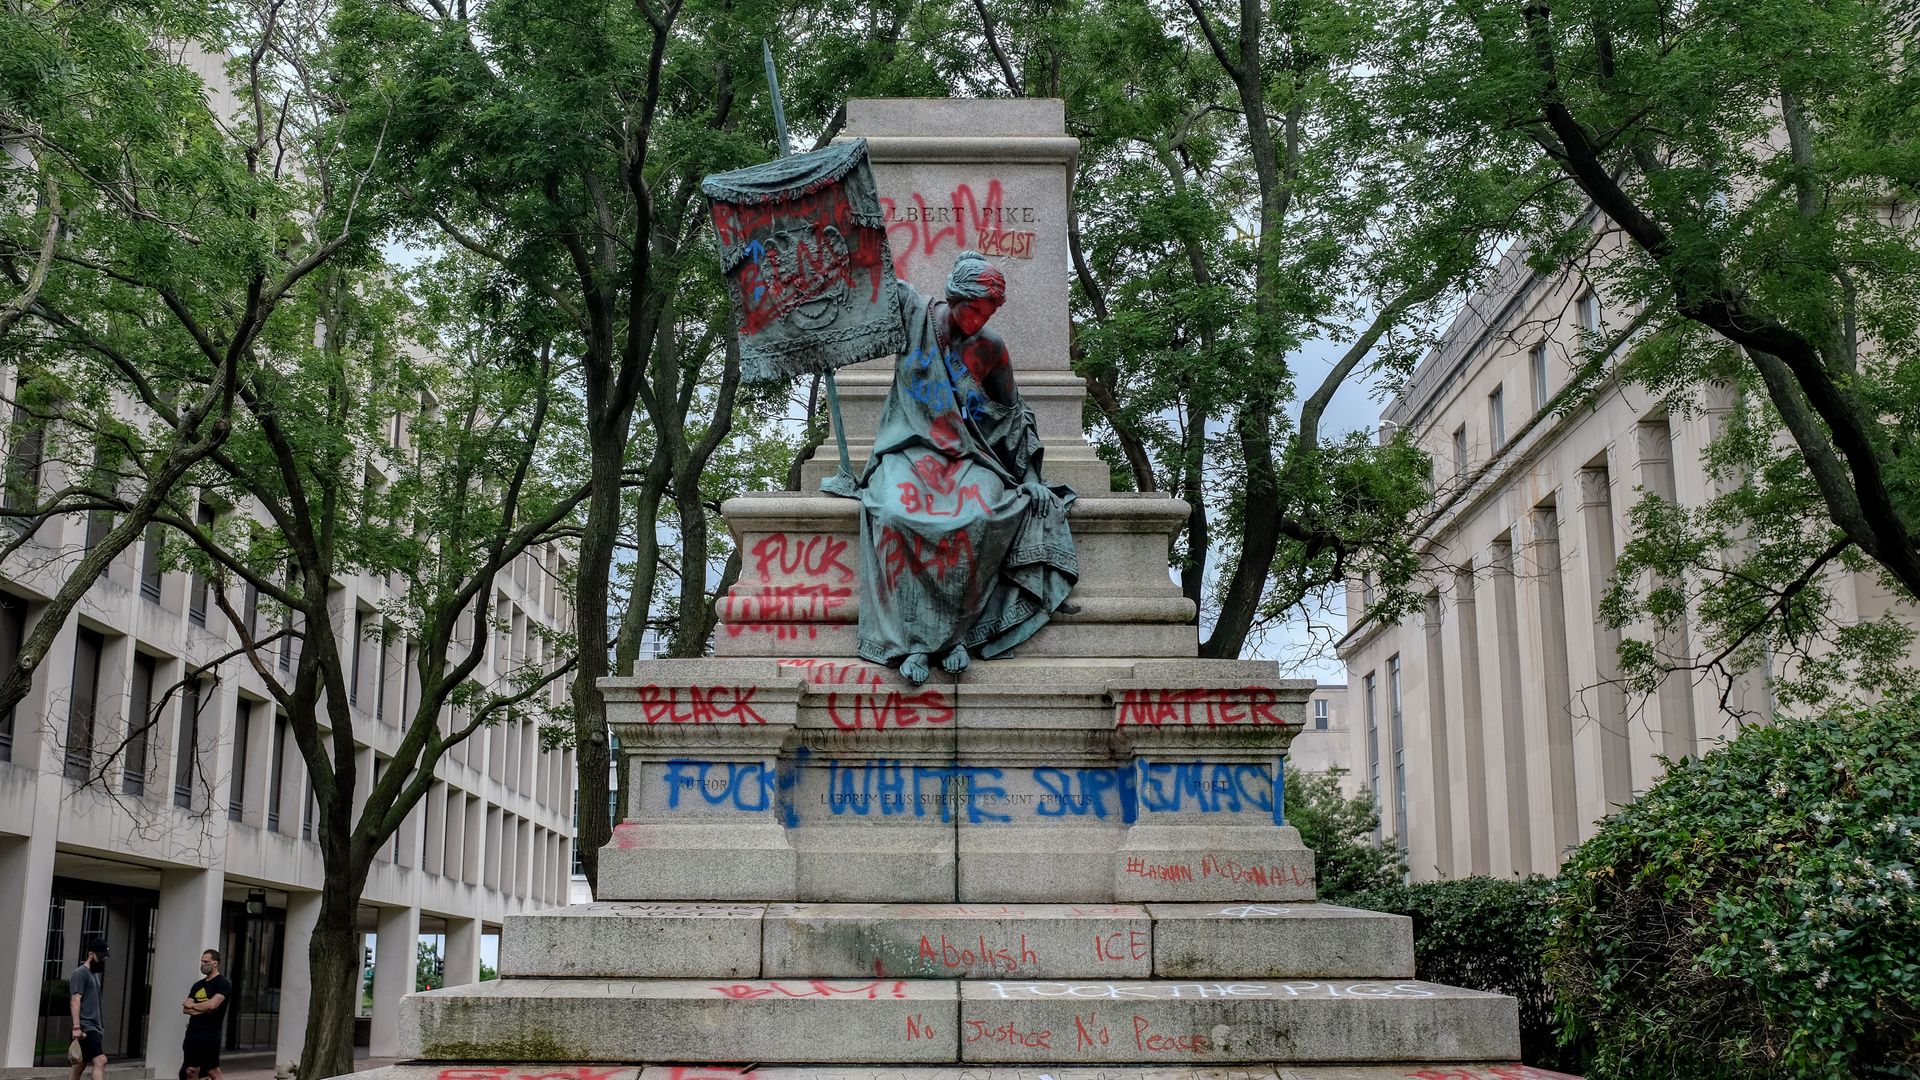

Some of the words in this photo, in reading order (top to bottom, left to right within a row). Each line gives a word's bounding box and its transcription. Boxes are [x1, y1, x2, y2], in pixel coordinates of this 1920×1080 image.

[884, 207, 964, 222] LBERT
[977, 229, 1036, 257] RACIST
[896, 482, 993, 517] BLM
[751, 533, 854, 583] FUCK
[878, 525, 977, 592] BLM
[725, 583, 852, 640] WHITE
[639, 684, 767, 726] BLACK
[827, 690, 955, 732] LIVES
[1116, 686, 1288, 729] MATTER
[664, 757, 811, 828] FUCK
[828, 758, 1012, 824] WHITE
[678, 779, 727, 791] AUTHOR
[820, 794, 877, 805] LABORUM
[1005, 794, 1034, 805] SUNT
[1194, 780, 1228, 793] POET
[919, 934, 1038, 972] Abolish
[1095, 930, 1148, 962] ICE
[988, 982, 1156, 998] FUCK
[1151, 983, 1273, 998] THE
[1283, 981, 1434, 997] PIGS
[906, 1013, 935, 1041] No
[965, 1019, 1053, 1051] Justice
[1132, 1015, 1208, 1054] Peace
